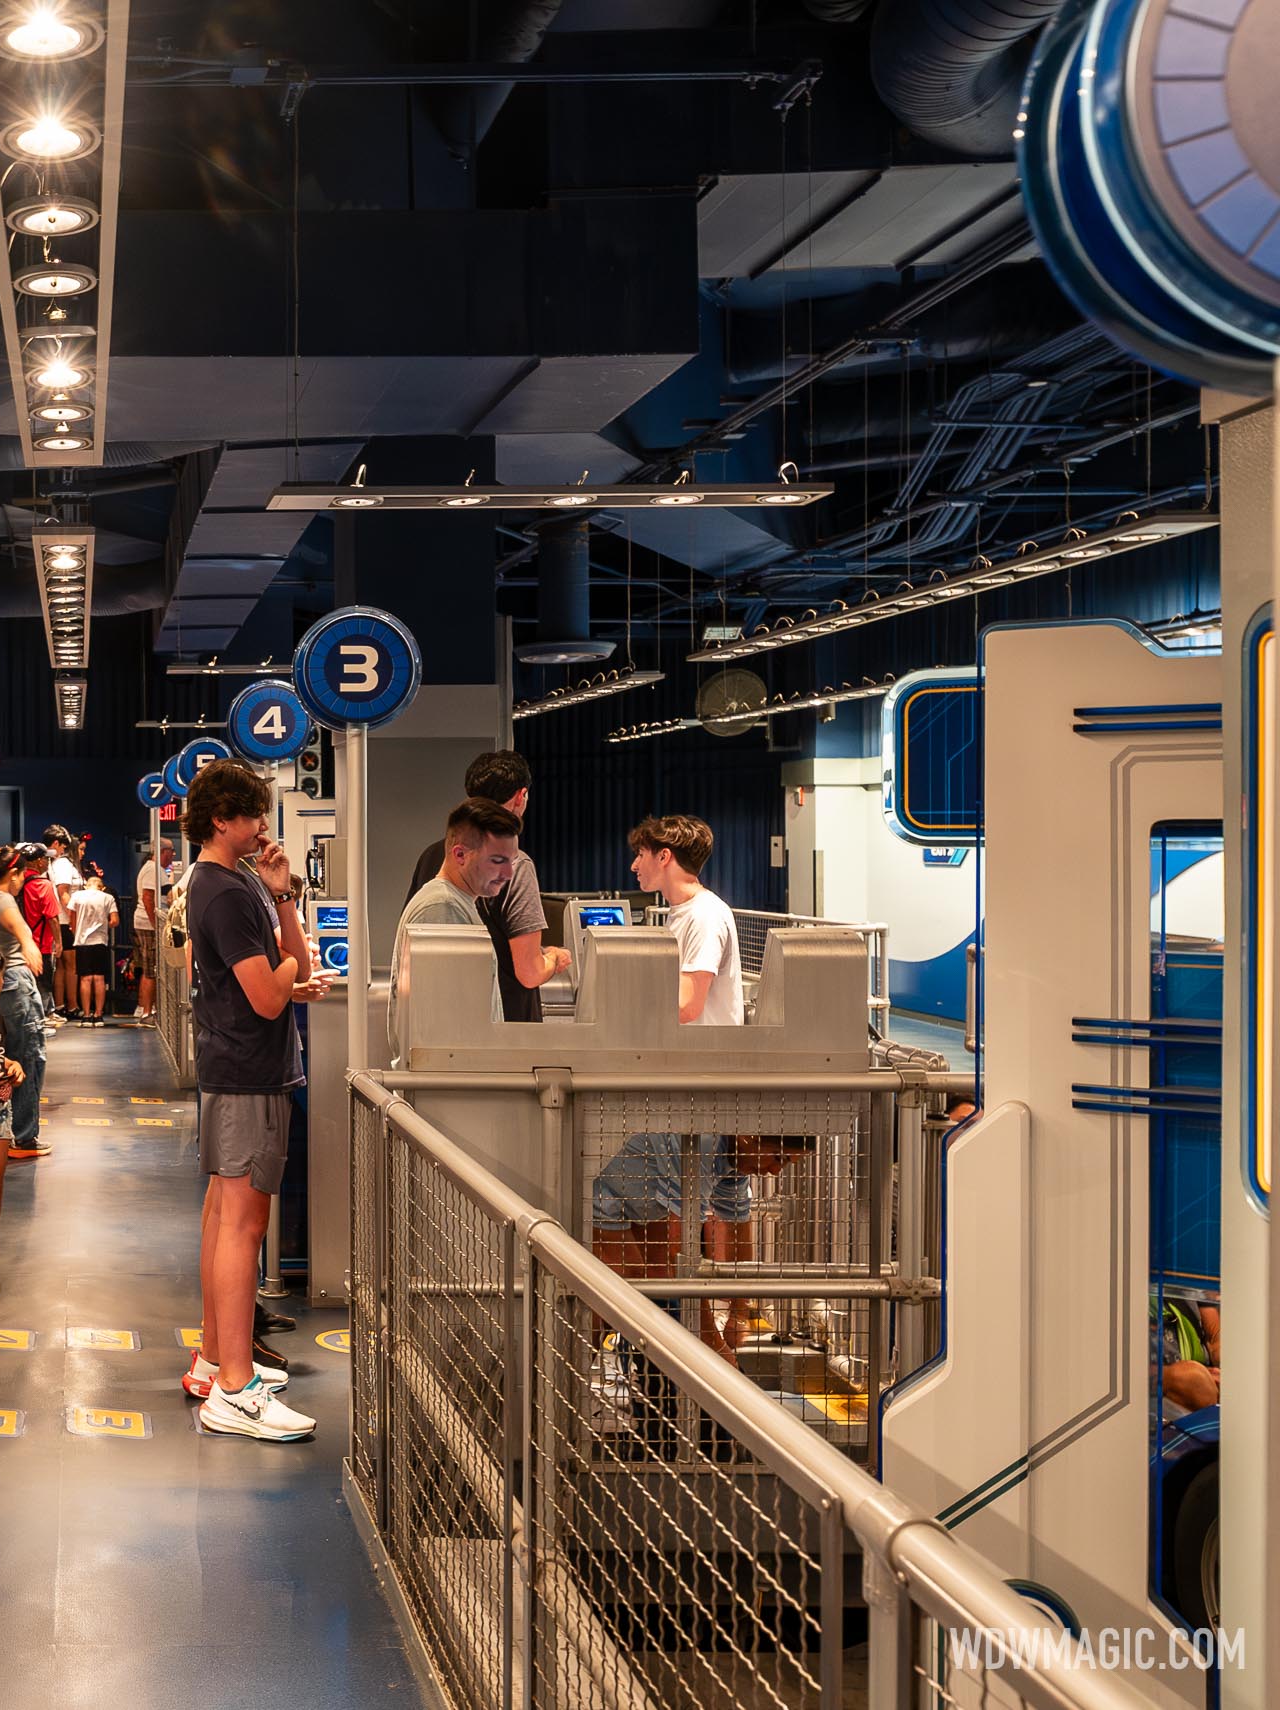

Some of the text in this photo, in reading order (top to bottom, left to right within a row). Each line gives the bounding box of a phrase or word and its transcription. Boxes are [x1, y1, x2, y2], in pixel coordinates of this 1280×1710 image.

[339, 645, 379, 693] 3
[253, 705, 286, 739] 4
[150, 783, 164, 799] 7
[87, 1414, 133, 1430] 3
